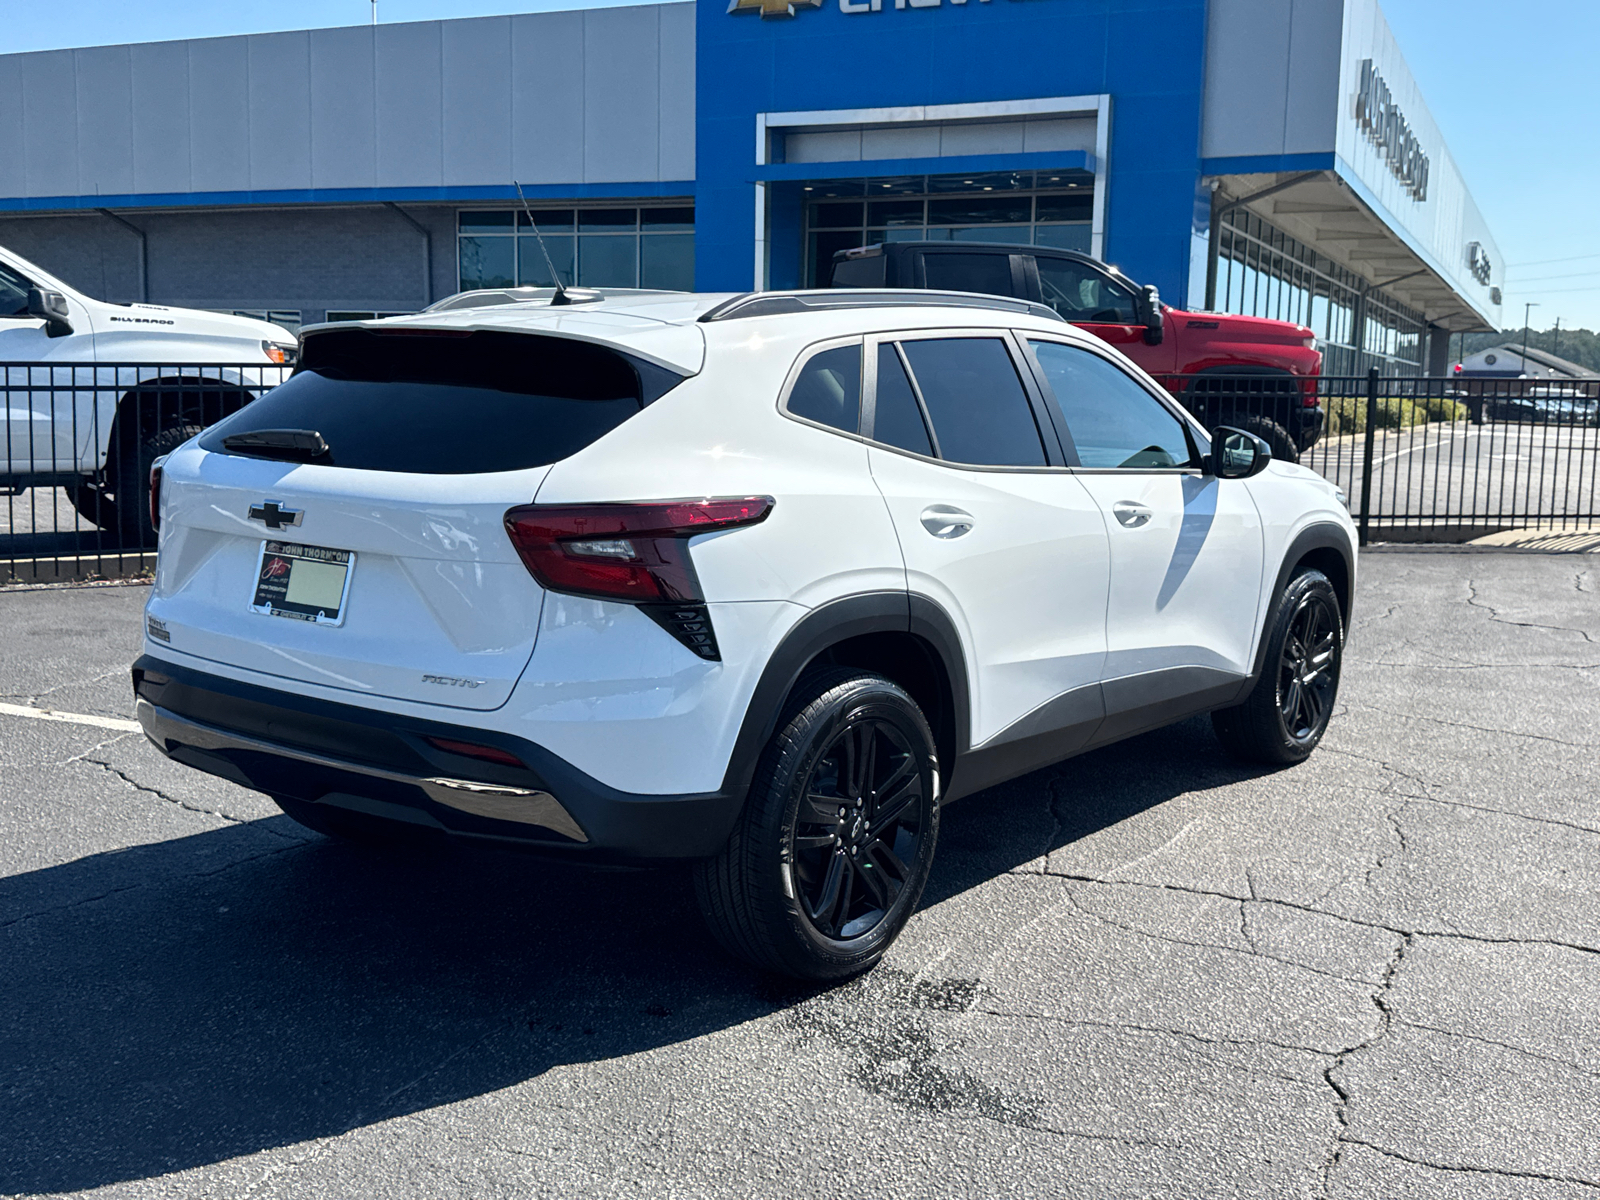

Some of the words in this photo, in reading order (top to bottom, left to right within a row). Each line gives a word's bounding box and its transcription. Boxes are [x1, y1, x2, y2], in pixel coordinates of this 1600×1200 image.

[110, 317, 174, 325] SILVERADO
[282, 545, 303, 556] JOHN
[304, 548, 349, 562] THORNTON
